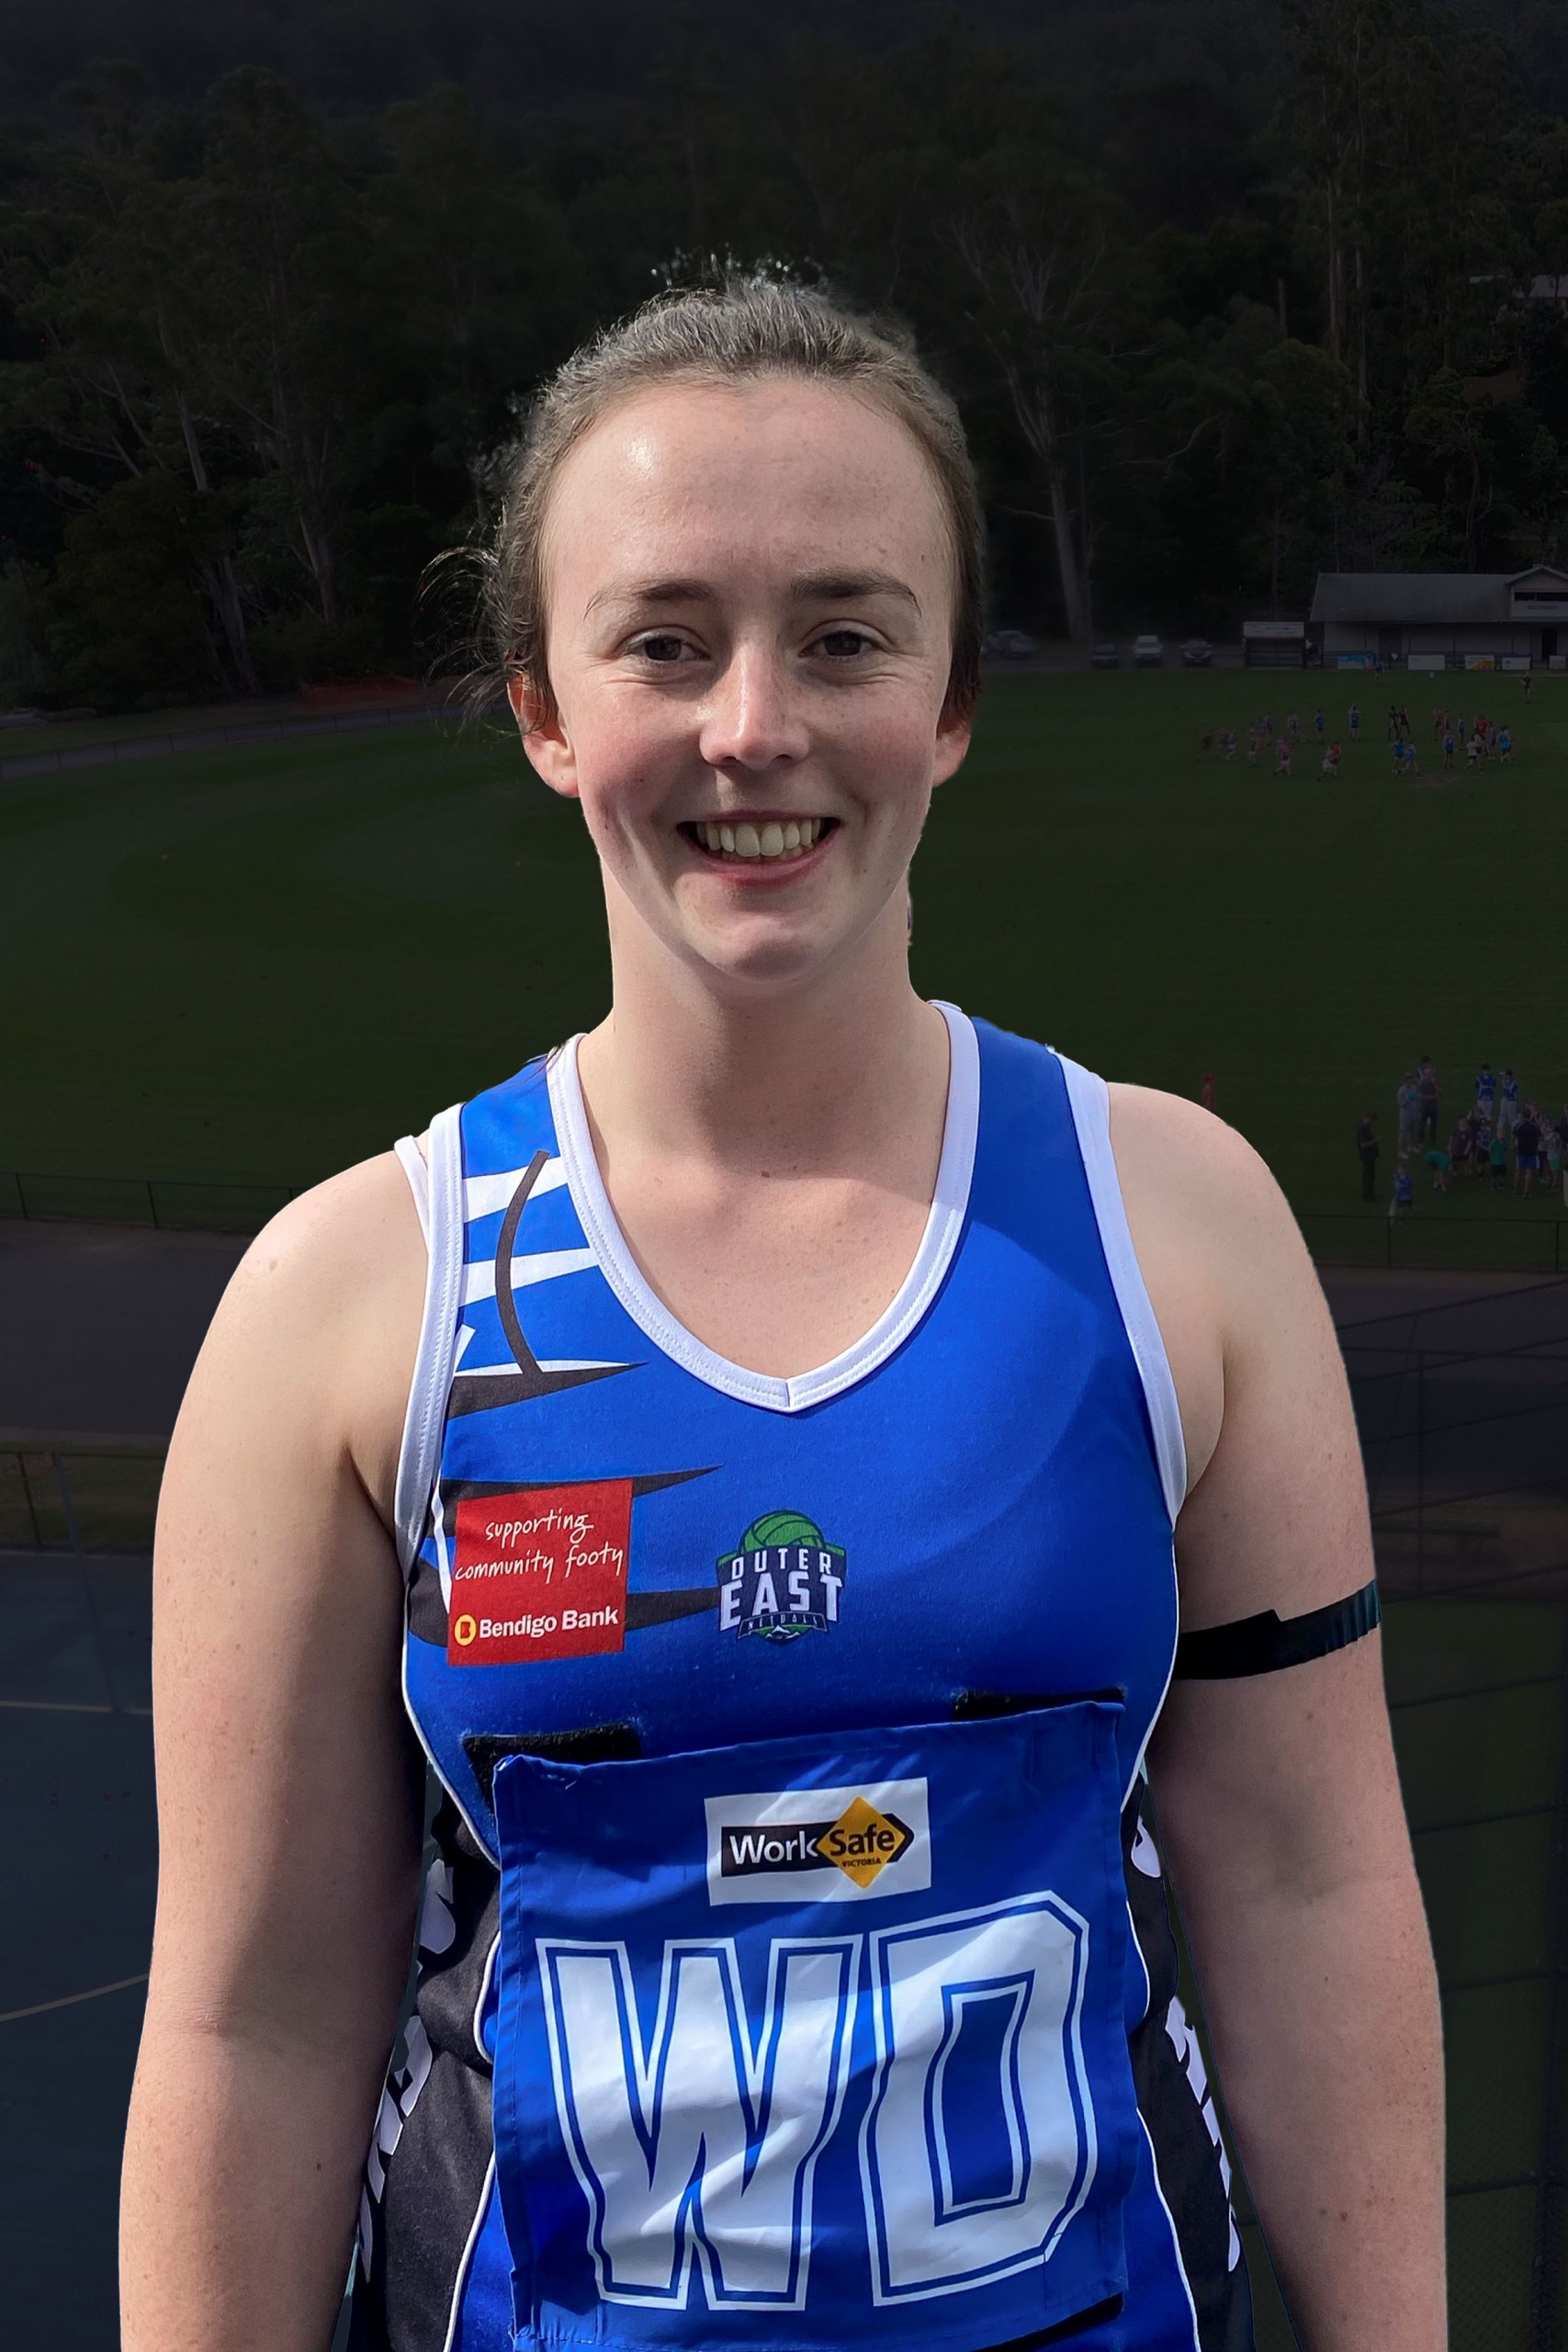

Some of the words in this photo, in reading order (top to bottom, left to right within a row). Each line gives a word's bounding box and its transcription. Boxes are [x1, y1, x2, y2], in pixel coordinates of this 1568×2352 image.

[485, 1508, 594, 1549] supporting
[455, 1549, 554, 1584] community
[565, 1541, 624, 1577] footy
[731, 1548, 831, 1580] OUTER
[719, 1571, 842, 1631] EAST
[479, 1614, 558, 1638] Bendigo
[561, 1605, 619, 1630] Bank
[841, 1858, 882, 1868] VICTORIA
